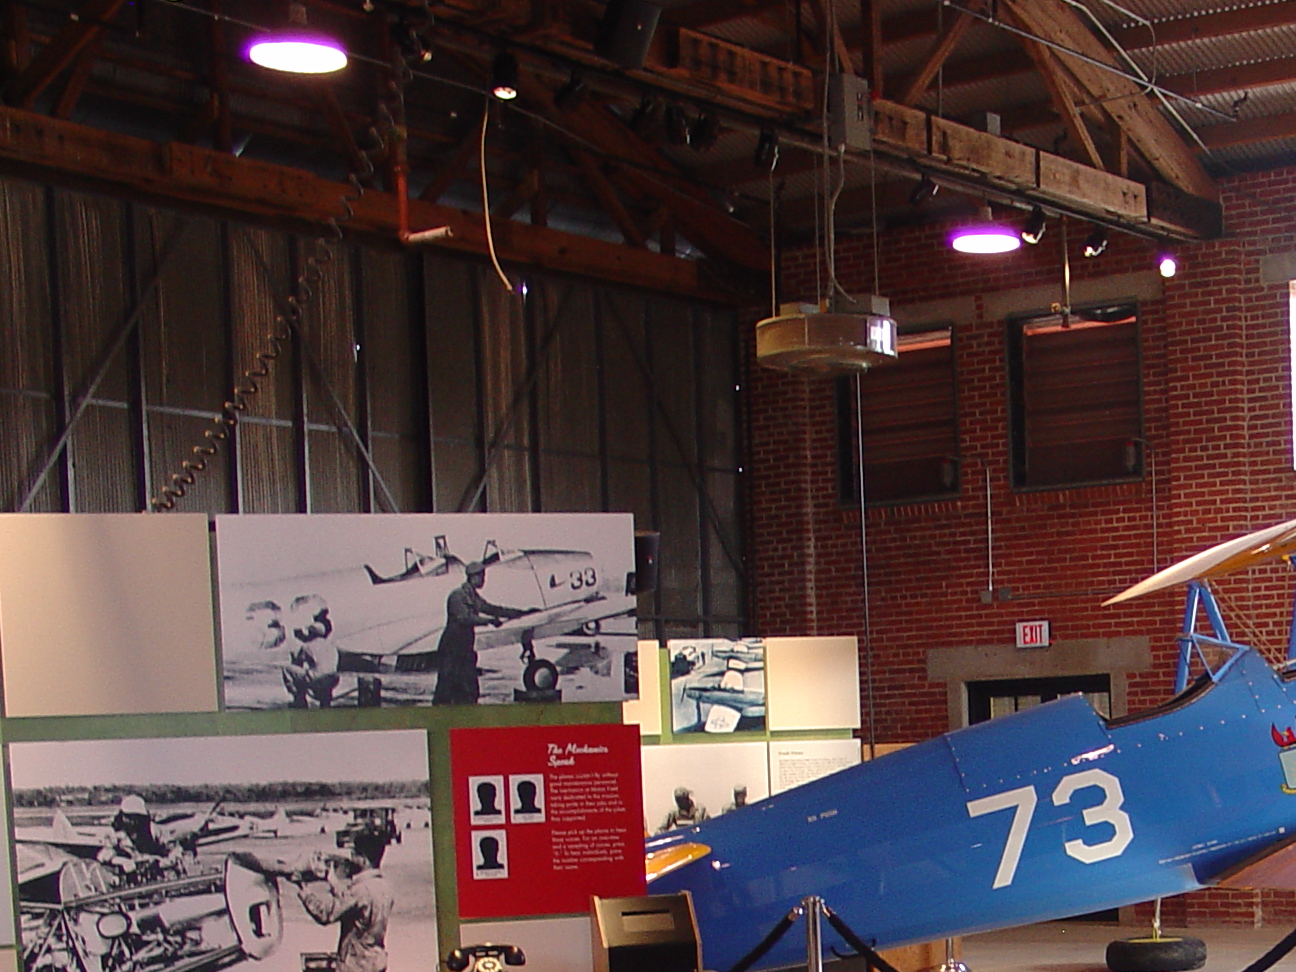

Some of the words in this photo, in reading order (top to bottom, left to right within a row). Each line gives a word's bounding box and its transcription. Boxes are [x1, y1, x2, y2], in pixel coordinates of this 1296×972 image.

[1021, 624, 1043, 644] EXIT
[547, 743, 563, 755] The
[565, 743, 608, 755] Mechanics
[547, 755, 575, 768] Speak
[966, 768, 1134, 890] 73
